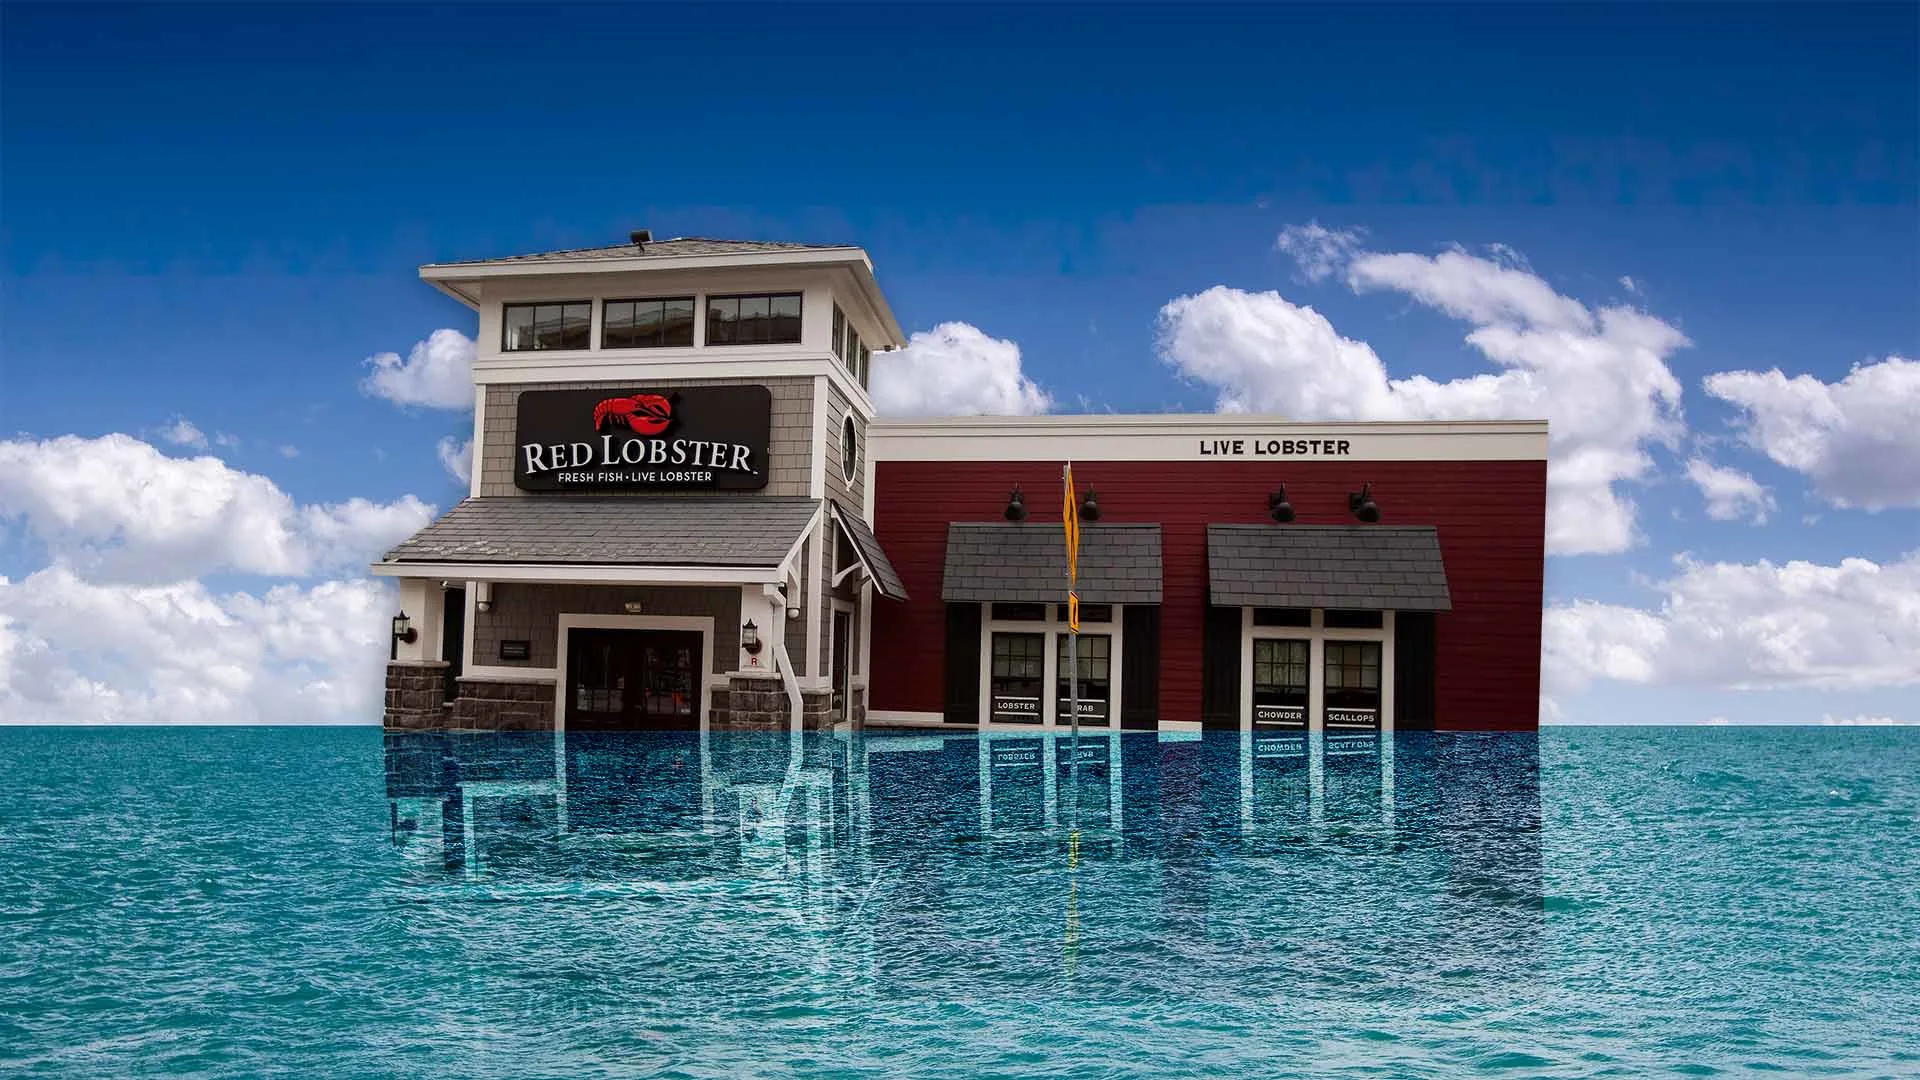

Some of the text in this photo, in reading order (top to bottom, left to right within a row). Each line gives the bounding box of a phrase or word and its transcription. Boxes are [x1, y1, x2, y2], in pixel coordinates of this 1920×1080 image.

[1199, 440, 1350, 455] LIVE LOBSTER
[522, 434, 751, 474] RED LOBSTER
[558, 472, 595, 482] FRESH
[660, 471, 712, 481] LOBSTER
[998, 702, 1036, 710] LOBSTER
[1075, 704, 1094, 712] RAB
[1258, 711, 1302, 720] CHOWDER
[1328, 713, 1375, 722] SCALLOPS
